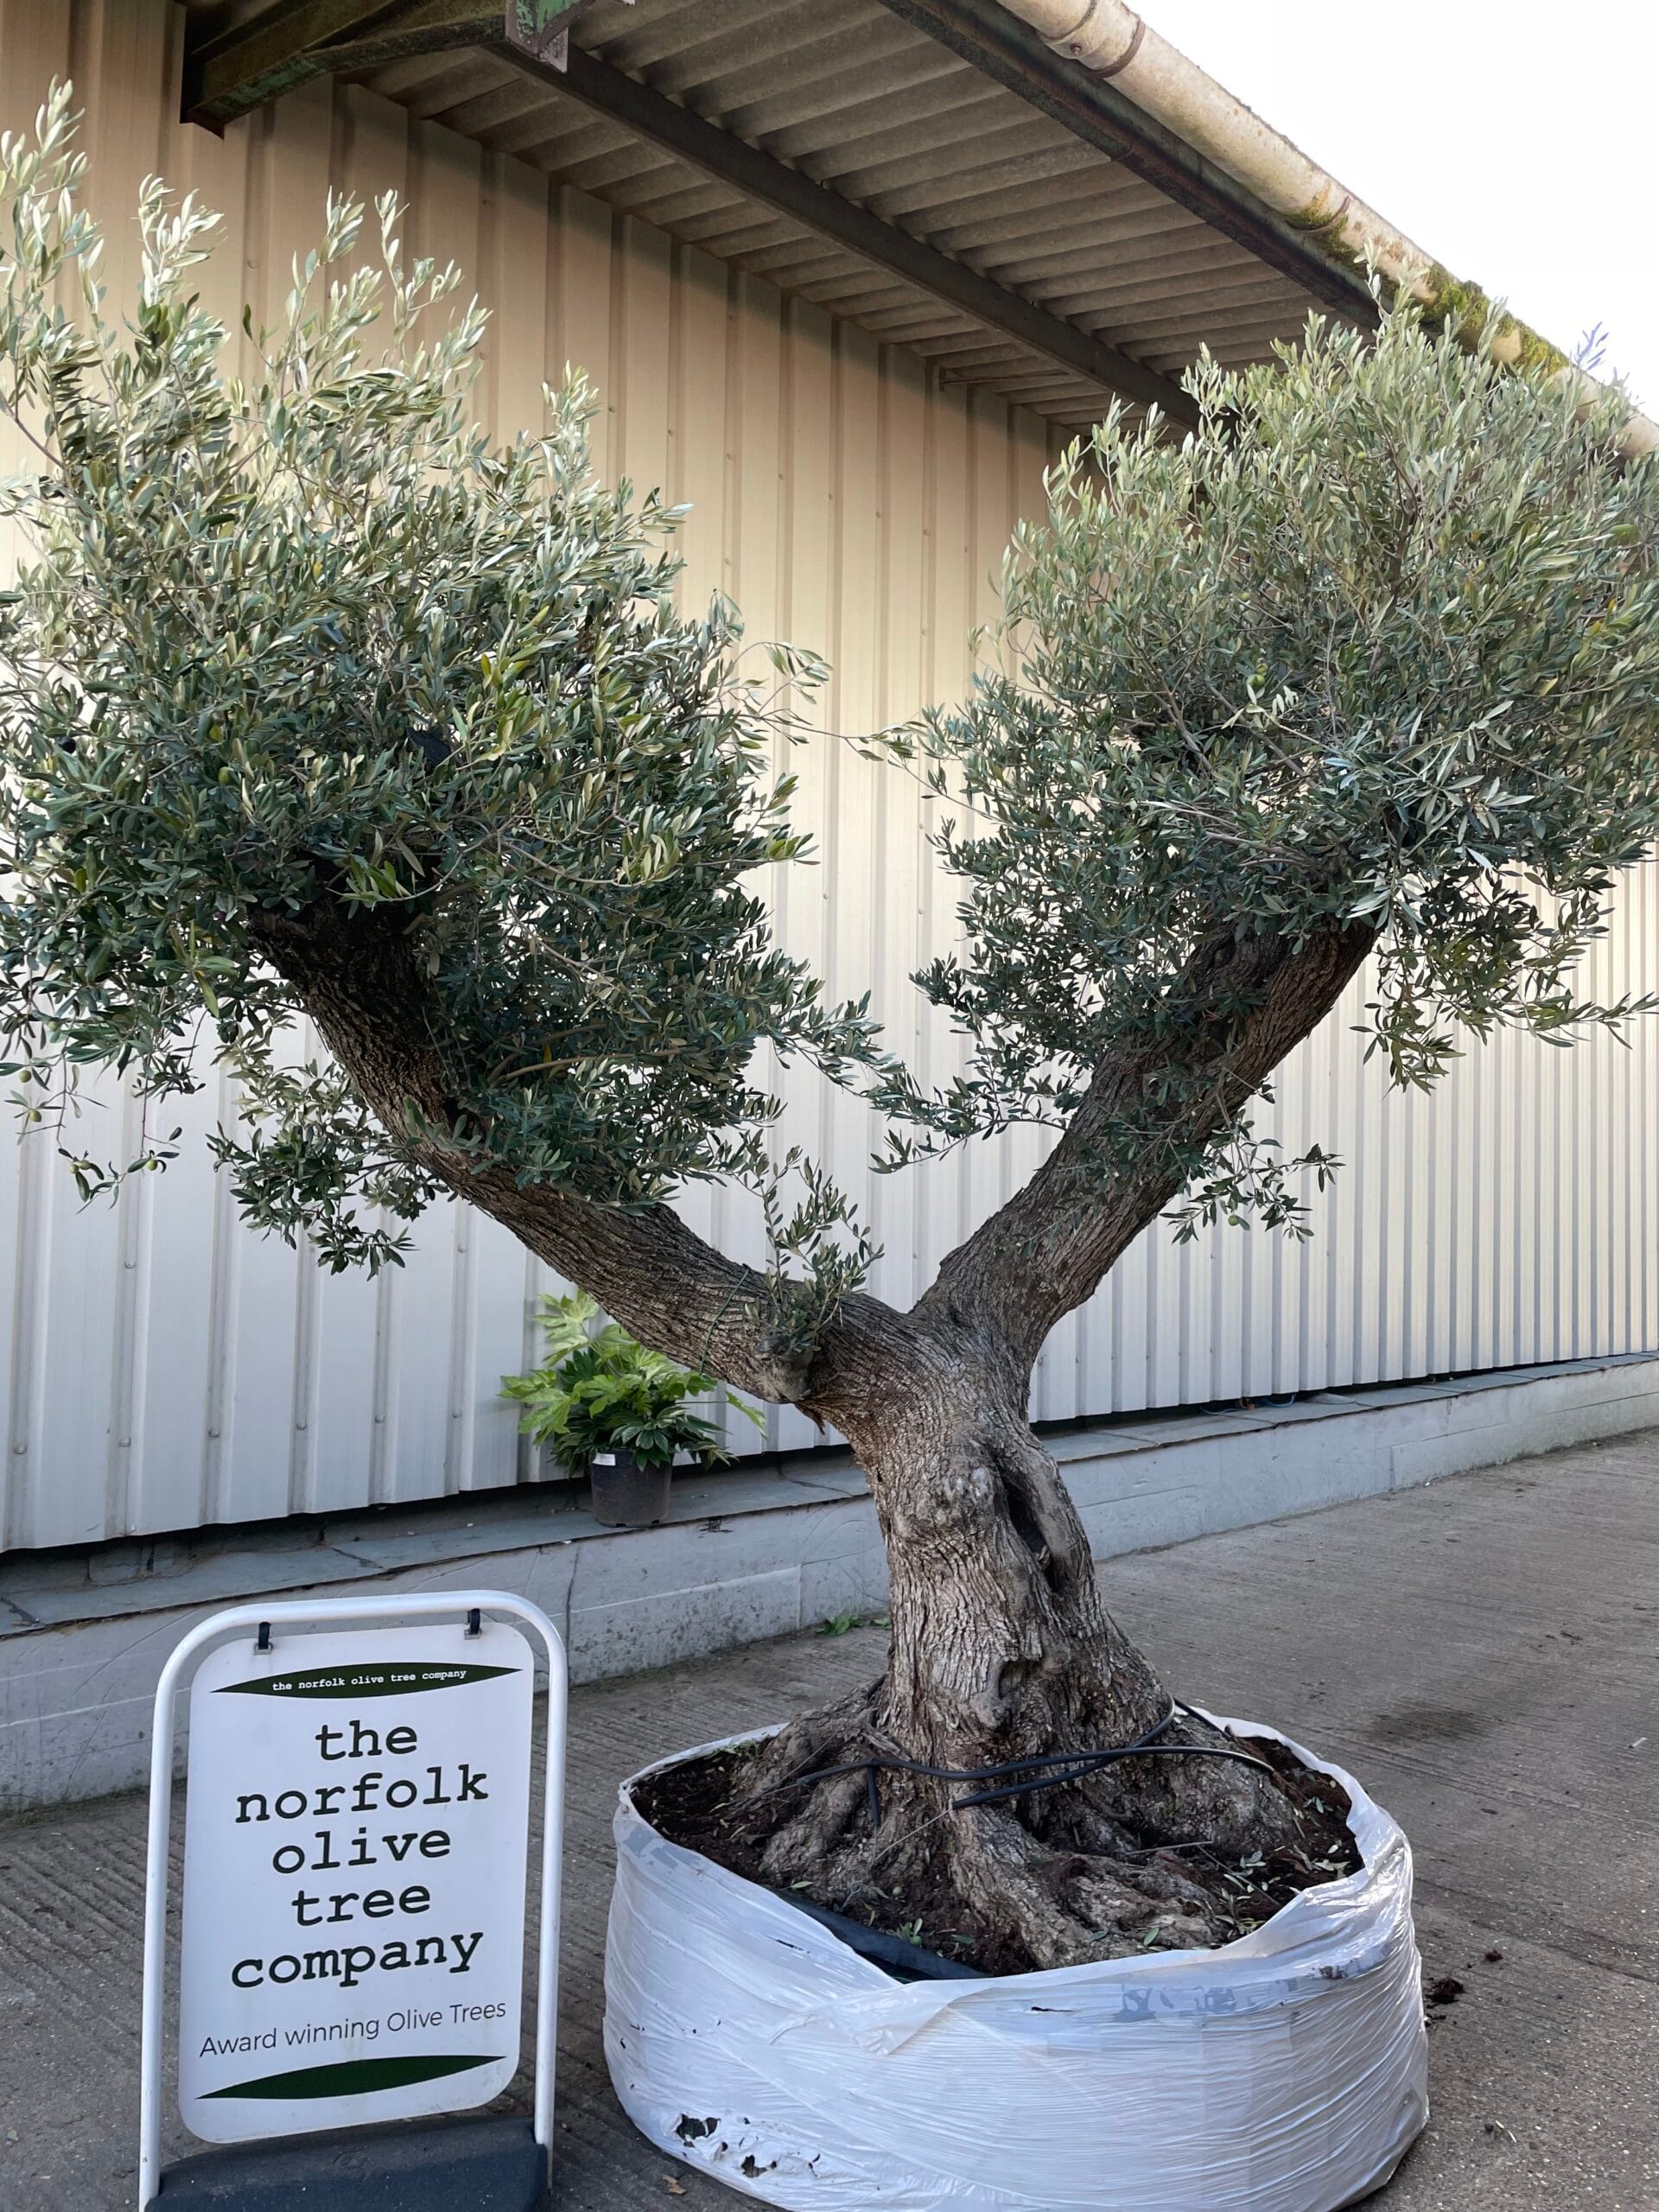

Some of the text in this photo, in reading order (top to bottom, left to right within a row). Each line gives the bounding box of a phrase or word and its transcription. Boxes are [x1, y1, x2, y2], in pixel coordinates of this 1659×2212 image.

[272, 1670, 467, 1691] the norfolk olive tree company
[315, 1720, 417, 1760] the
[235, 1764, 488, 1823] norfolk
[273, 1827, 450, 1873] olive
[291, 1885, 430, 1926] tree
[232, 1932, 483, 1988] company
[200, 2003, 505, 2057] Award winning Olive Trees
